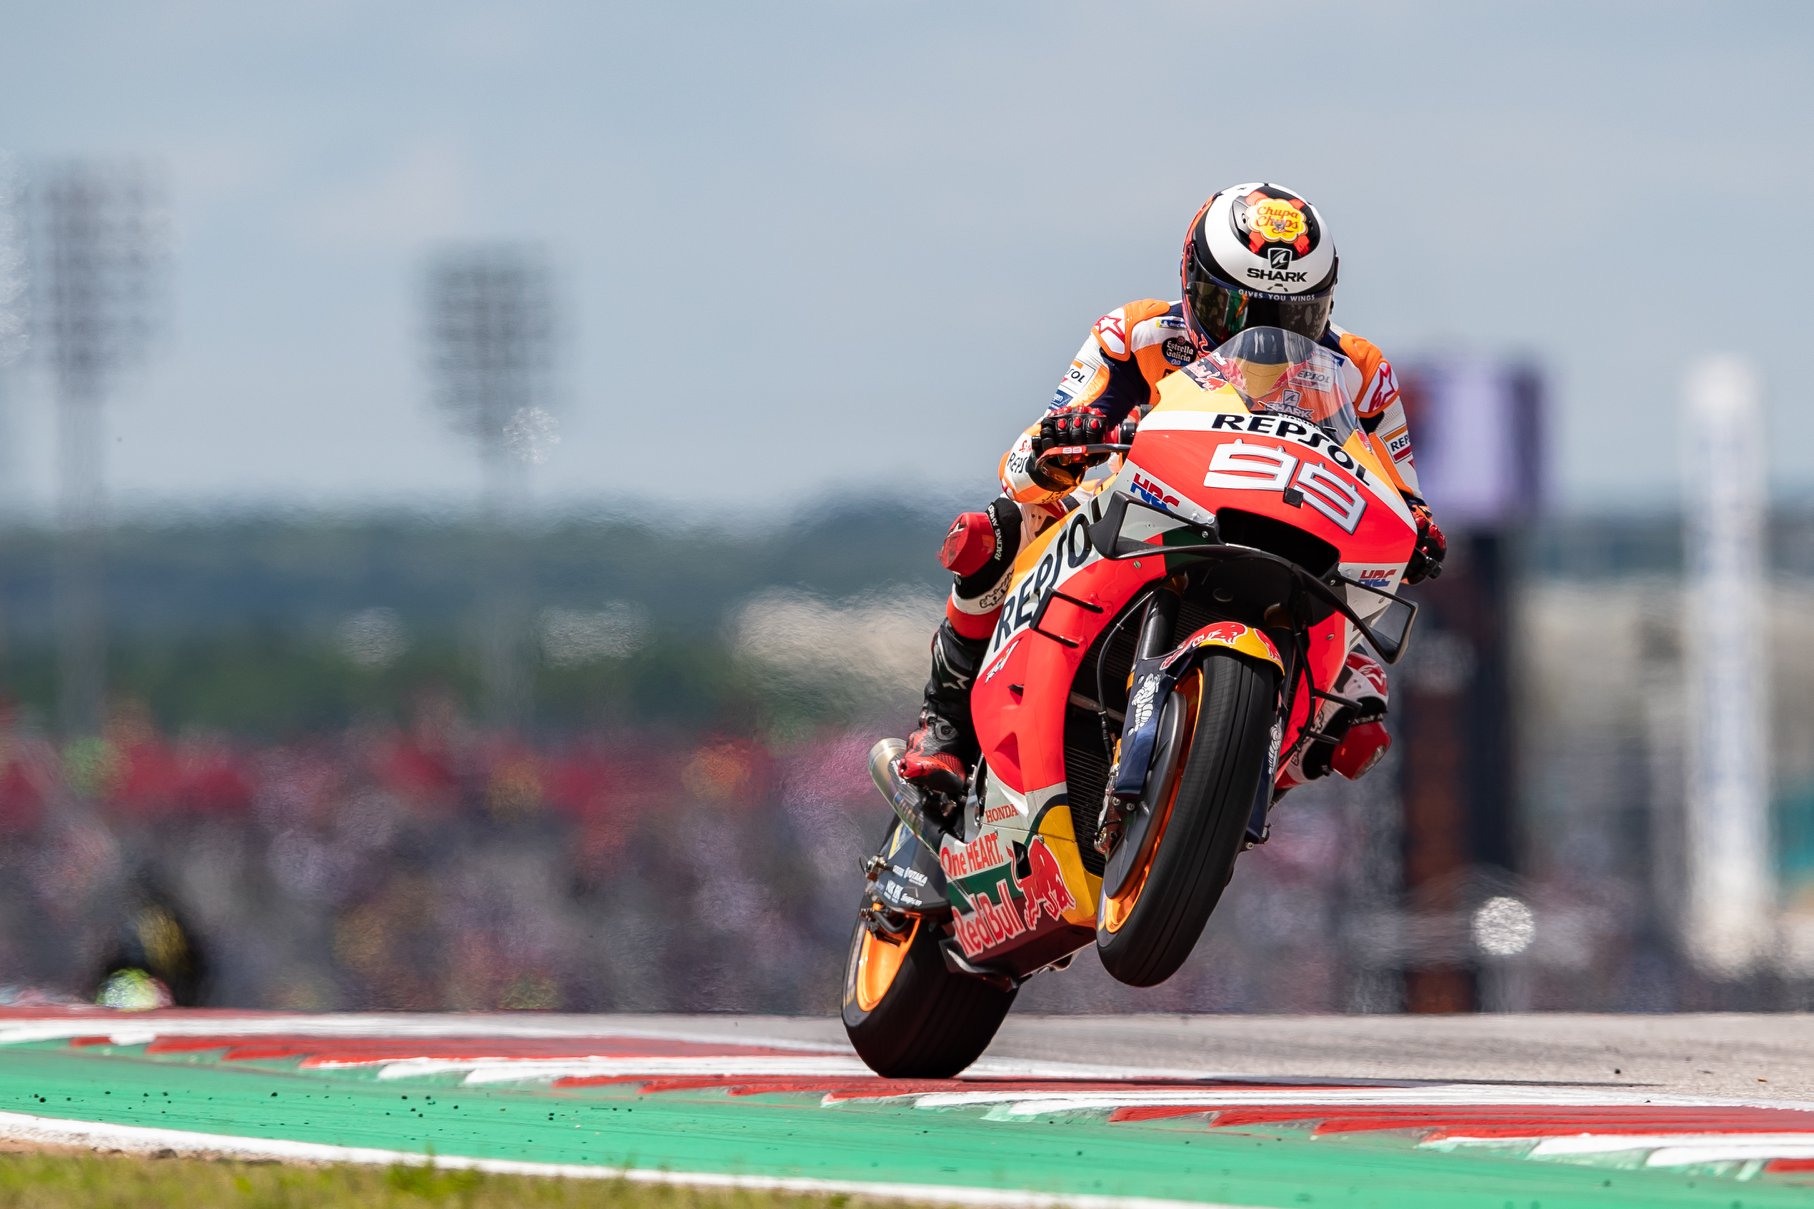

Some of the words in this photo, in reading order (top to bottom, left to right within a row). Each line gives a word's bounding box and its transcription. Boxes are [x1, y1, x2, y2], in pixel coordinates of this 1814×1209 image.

[1257, 206, 1299, 219] Chupa
[1247, 268, 1308, 282] SHARK
[1238, 289, 1263, 298] GIVES
[1290, 294, 1315, 302] WINGS
[1166, 341, 1194, 355] Estrella
[1166, 349, 1191, 362] Galicia
[1066, 368, 1085, 384] SOL
[1297, 369, 1331, 384] EPSOL
[1212, 414, 1372, 486] REPSOL
[1390, 434, 1410, 451] REP
[1007, 452, 1028, 474] REPS
[1130, 473, 1180, 511] HRC
[1203, 438, 1367, 535] 99
[985, 803, 1020, 823] HONDA
[940, 846, 967, 878] One
[951, 893, 997, 958] Red
[976, 879, 1027, 945] Bull
